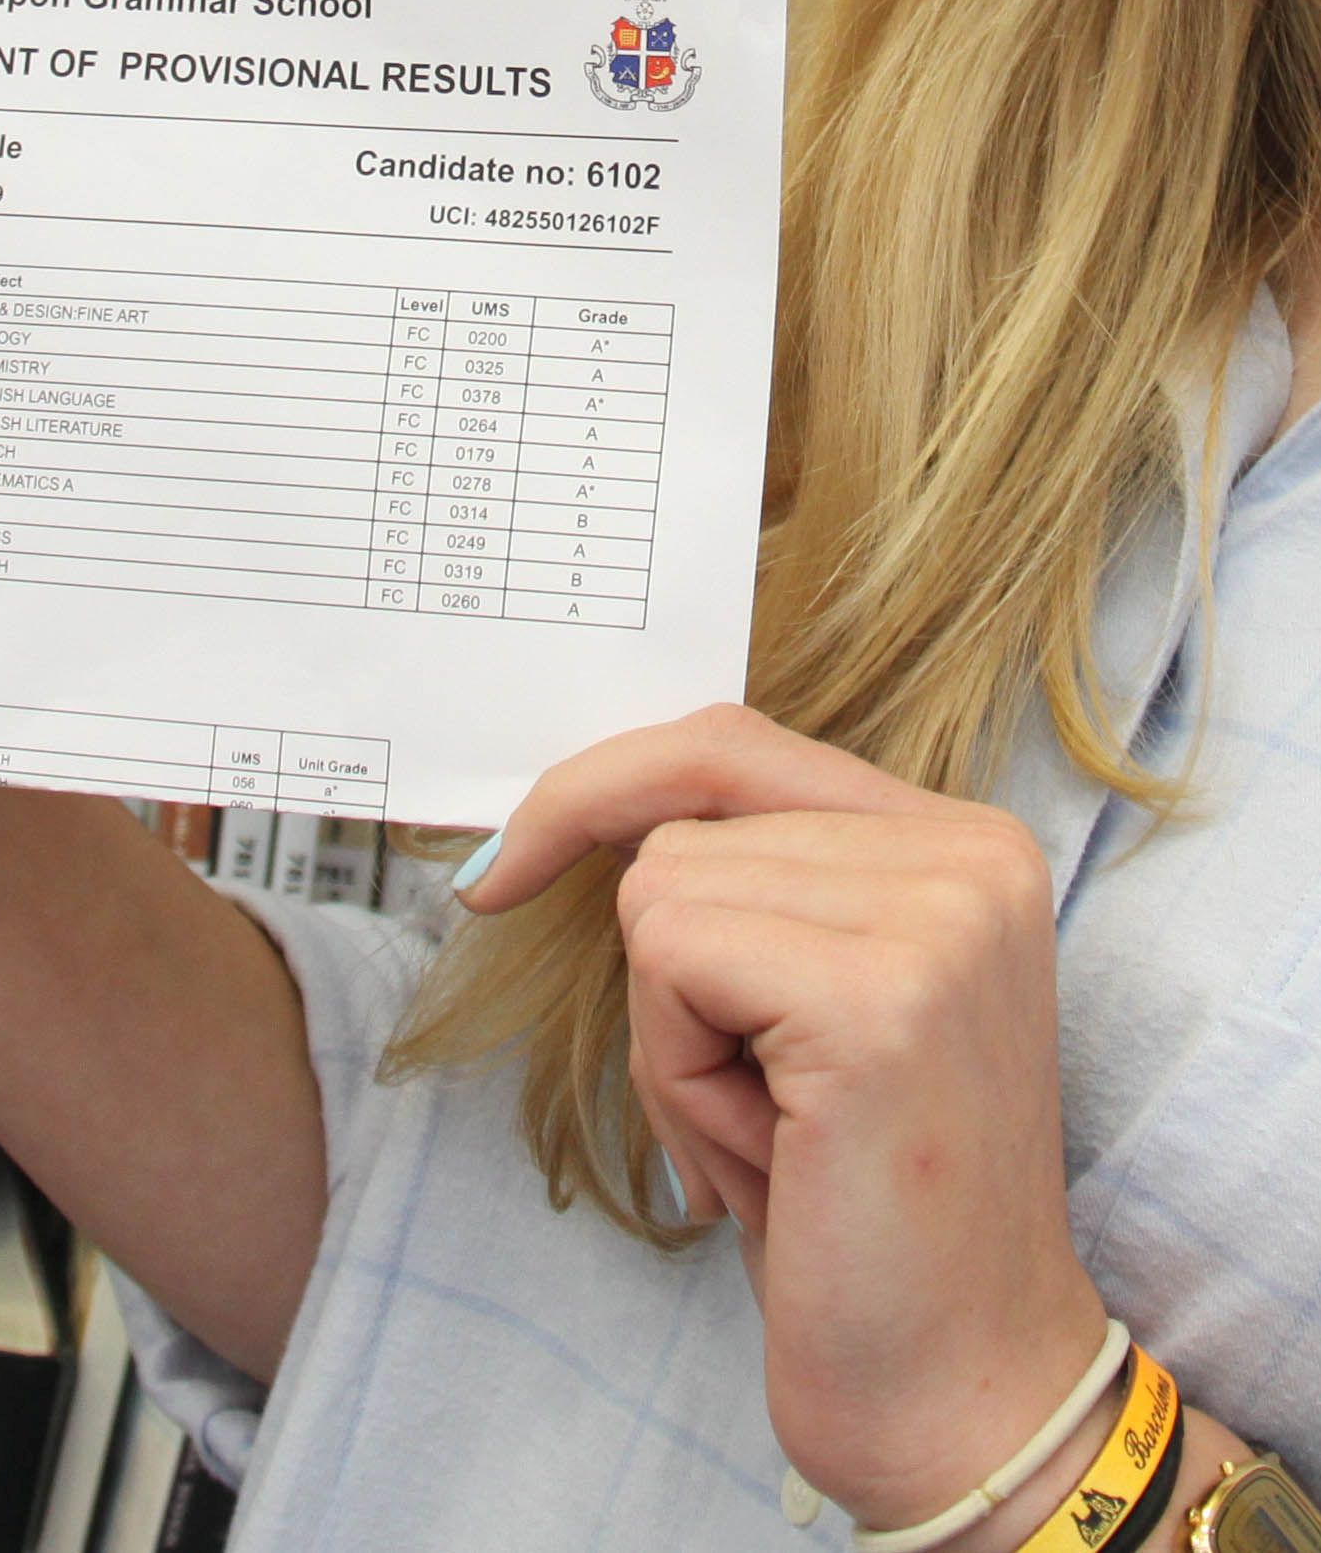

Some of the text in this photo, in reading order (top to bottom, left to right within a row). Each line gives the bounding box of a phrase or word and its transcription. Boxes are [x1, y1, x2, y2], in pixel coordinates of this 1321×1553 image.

[50, 49, 98, 78] OF
[120, 52, 369, 91] PROVISIONAL
[382, 62, 552, 98] RESULTS
[356, 150, 661, 189] Candidate no: 6102
[430, 206, 660, 235] UCI: 482550126102F
[0, 304, 8, 315] &
[117, 309, 149, 324] ART
[407, 327, 430, 341] FC
[468, 331, 507, 346] 0200
[401, 298, 443, 313] Level
[471, 302, 510, 317] UMS
[579, 309, 628, 325] Grade
[465, 360, 504, 375] 0325
[592, 370, 603, 382] A
[462, 389, 501, 404] 0378
[29, 390, 116, 408] LANGUAGE
[459, 418, 497, 433] 0264
[586, 428, 598, 440] A
[27, 418, 123, 437] LITERATURE
[456, 447, 494, 463] 0179
[583, 457, 594, 469] A
[453, 476, 491, 492] 0278
[63, 478, 74, 492] A
[450, 506, 487, 520] 0314
[578, 515, 587, 527] B
[447, 535, 485, 550] 0249
[574, 545, 585, 557] A
[444, 564, 482, 579] 0319
[571, 574, 581, 587] B
[441, 594, 480, 609] 0260
[567, 603, 579, 616] A
[299, 758, 368, 774] Unit Grade
